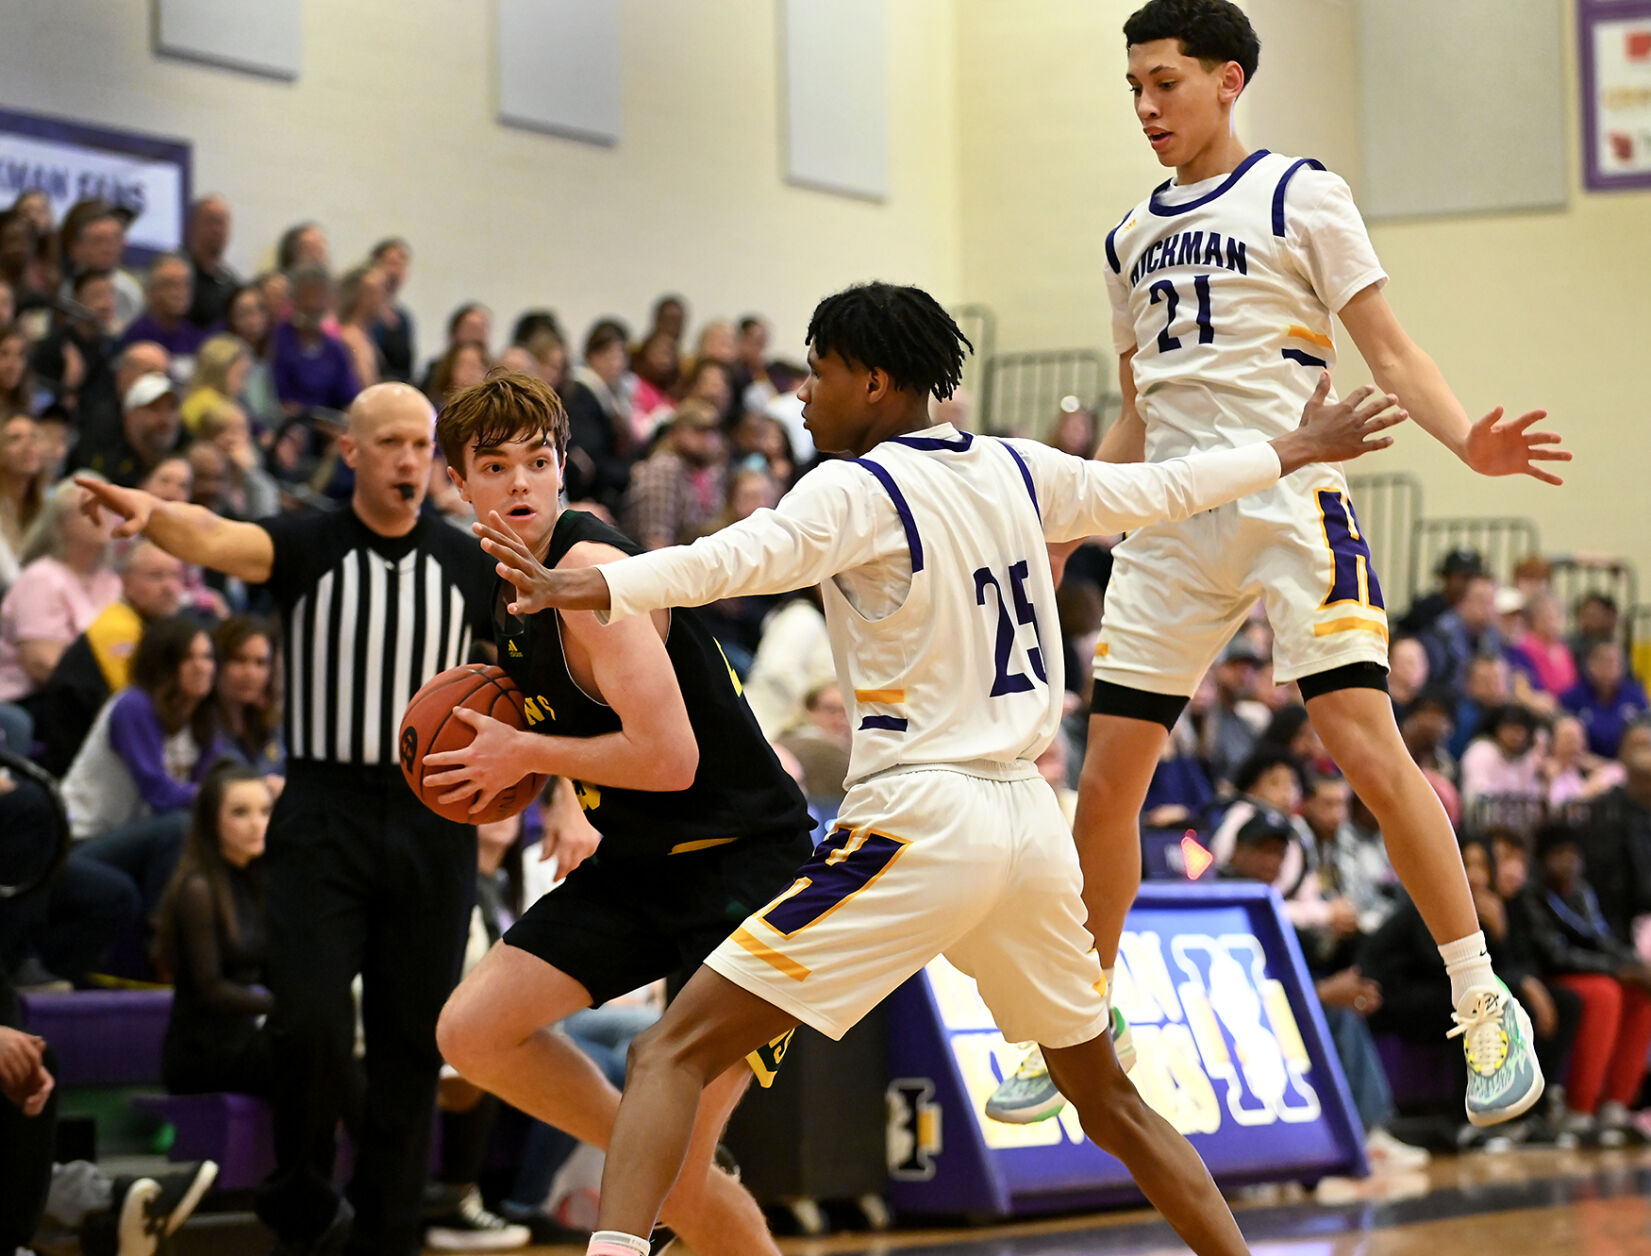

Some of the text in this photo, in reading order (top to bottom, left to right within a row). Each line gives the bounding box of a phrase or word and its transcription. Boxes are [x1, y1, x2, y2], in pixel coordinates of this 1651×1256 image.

[1130, 231, 1248, 288] HICKMAN
[1149, 274, 1215, 354] 21
[973, 560, 1049, 698] 25
